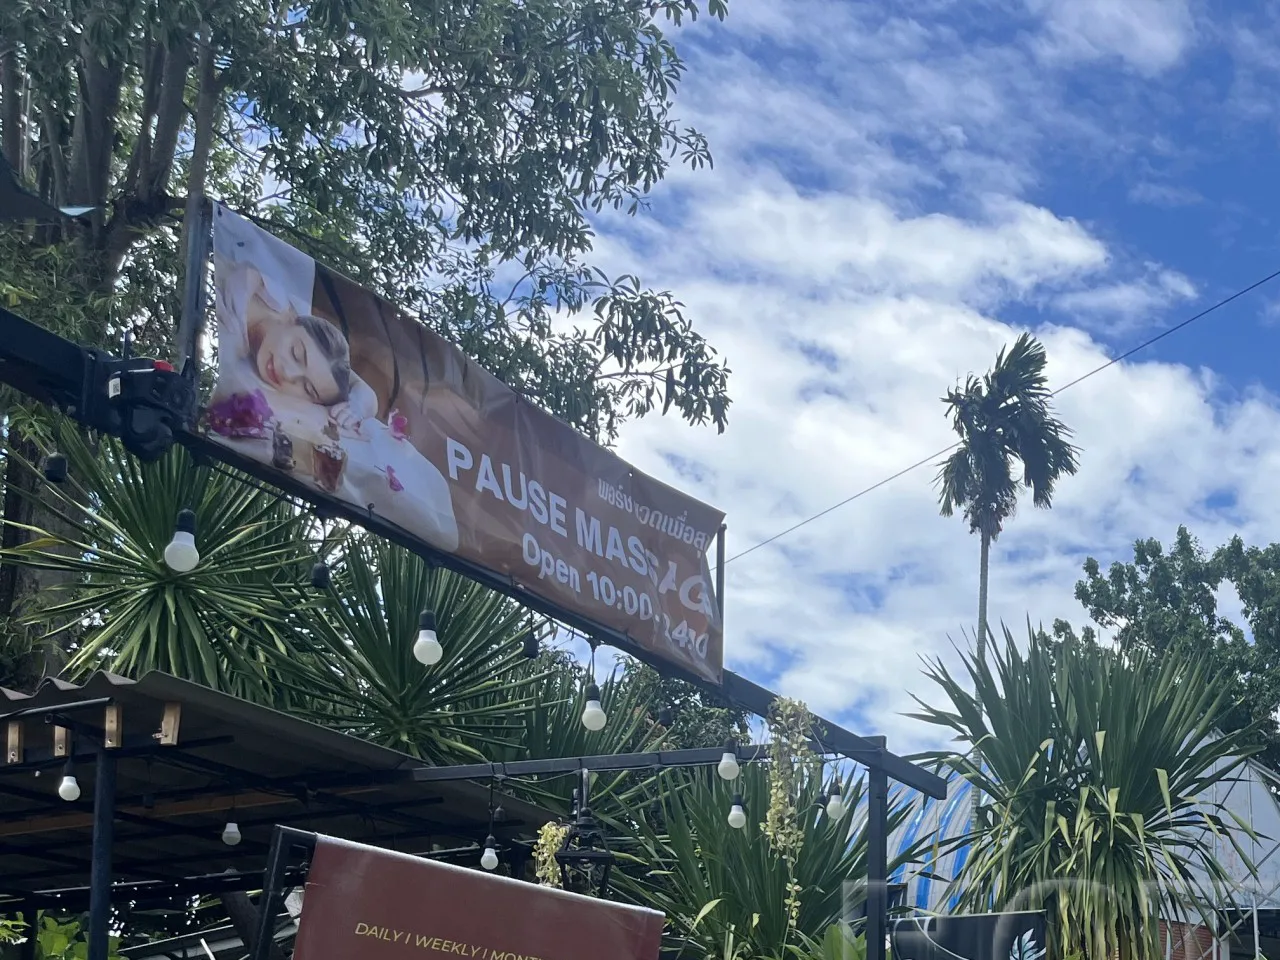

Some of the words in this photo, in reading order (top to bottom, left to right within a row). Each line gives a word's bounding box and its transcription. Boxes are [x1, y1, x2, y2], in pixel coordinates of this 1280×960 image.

[446, 437, 568, 538] PAUSE
[575, 507, 713, 618] MASSAG
[522, 532, 581, 593] Open
[355, 921, 404, 946] DAILY
[415, 934, 480, 958] WEEKLY
